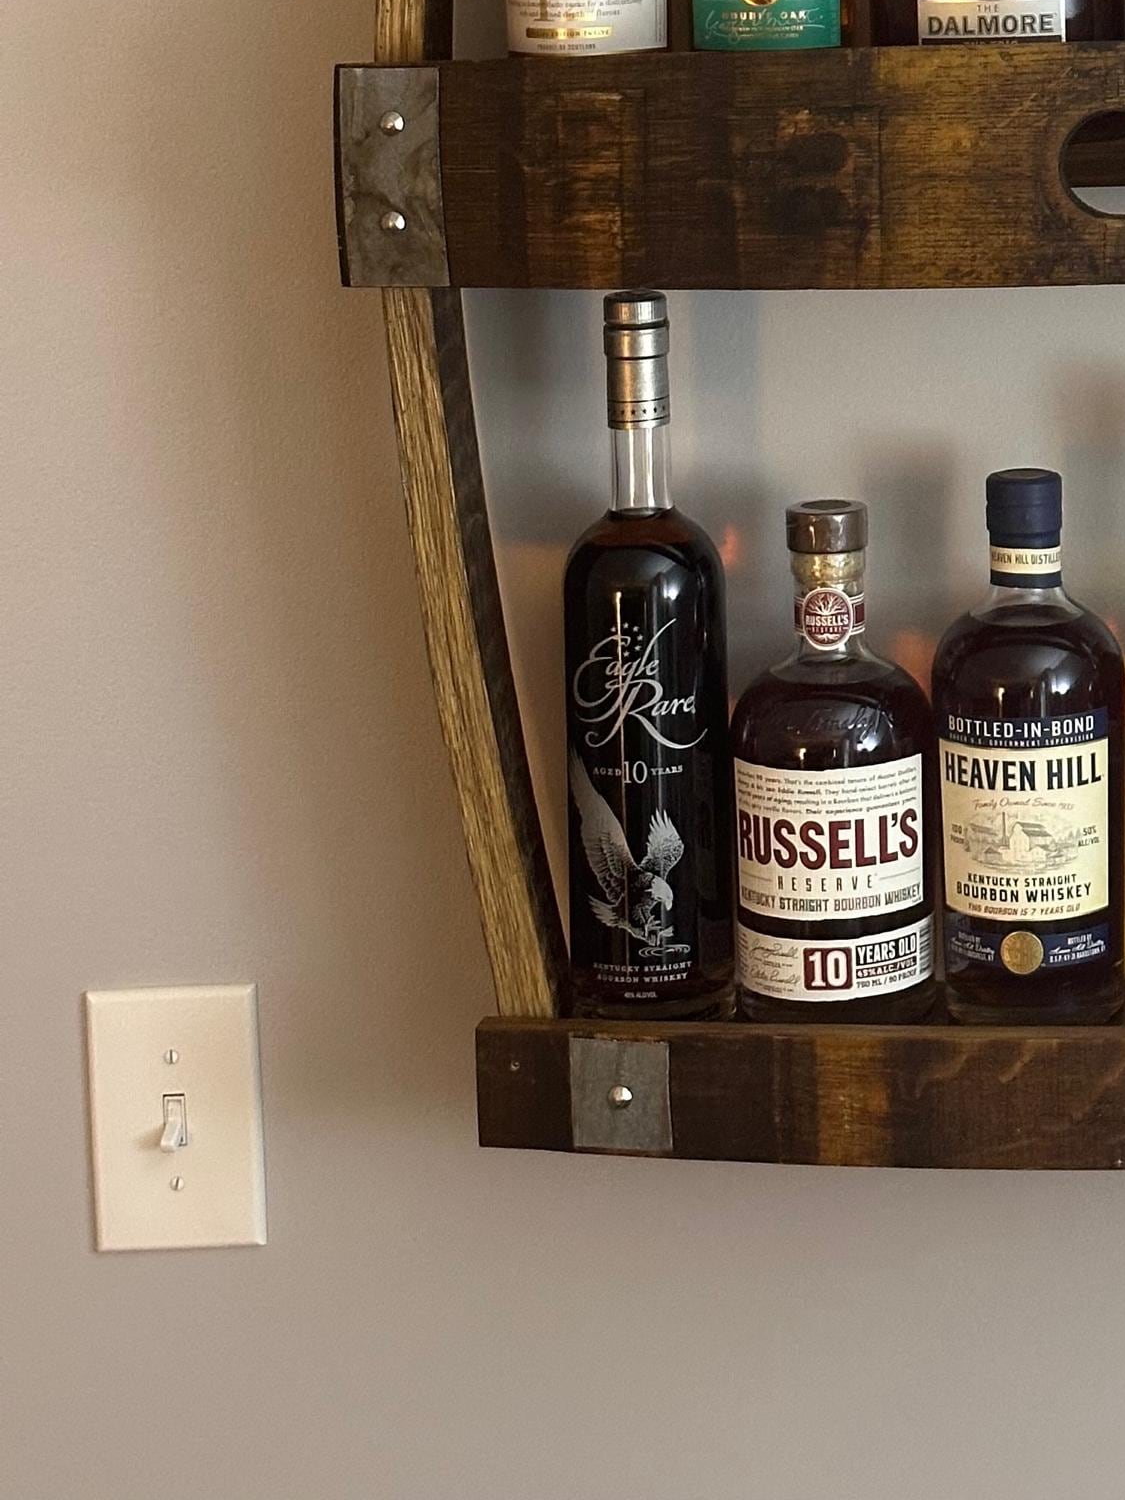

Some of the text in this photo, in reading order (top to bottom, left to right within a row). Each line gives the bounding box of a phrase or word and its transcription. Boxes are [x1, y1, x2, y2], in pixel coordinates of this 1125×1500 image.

[780, 10, 807, 19] OAK
[977, 4, 999, 13] THE
[928, 14, 1054, 36] DALMORE
[1015, 553, 1030, 565] HILL
[806, 614, 849, 627] RUSSELL'S
[573, 618, 677, 722] Eagle
[585, 678, 708, 749] Rare
[948, 714, 1094, 738] BOTTLED-IN-BOND
[989, 738, 1040, 747] GOVERNMENT
[1045, 732, 1094, 746] SUPERVISION
[593, 760, 683, 784] AGED 10 YEARS
[945, 751, 1102, 791] HEAVEN HILL
[739, 807, 918, 870] RUSSELL'S
[778, 875, 873, 892] RESERVE
[968, 873, 1077, 887] KENTUCKY STRAIGHT
[741, 882, 921, 912] KENTUCKY STRAIGHT BOURBON WHISKEY
[957, 881, 1091, 903] BOURBON WHISKEY
[968, 903, 982, 912] THIS
[983, 906, 1018, 916] BOURBON
[1020, 907, 1028, 915] IS
[1040, 906, 1063, 915] YEARS
[1067, 904, 1080, 912] OLD
[594, 961, 692, 973] KENTUCKY STRAIGHT
[809, 950, 848, 987] 10
[858, 943, 895, 965] YEARS
[898, 934, 917, 953] OLD
[597, 973, 688, 983] BOURBON WHISKEY
